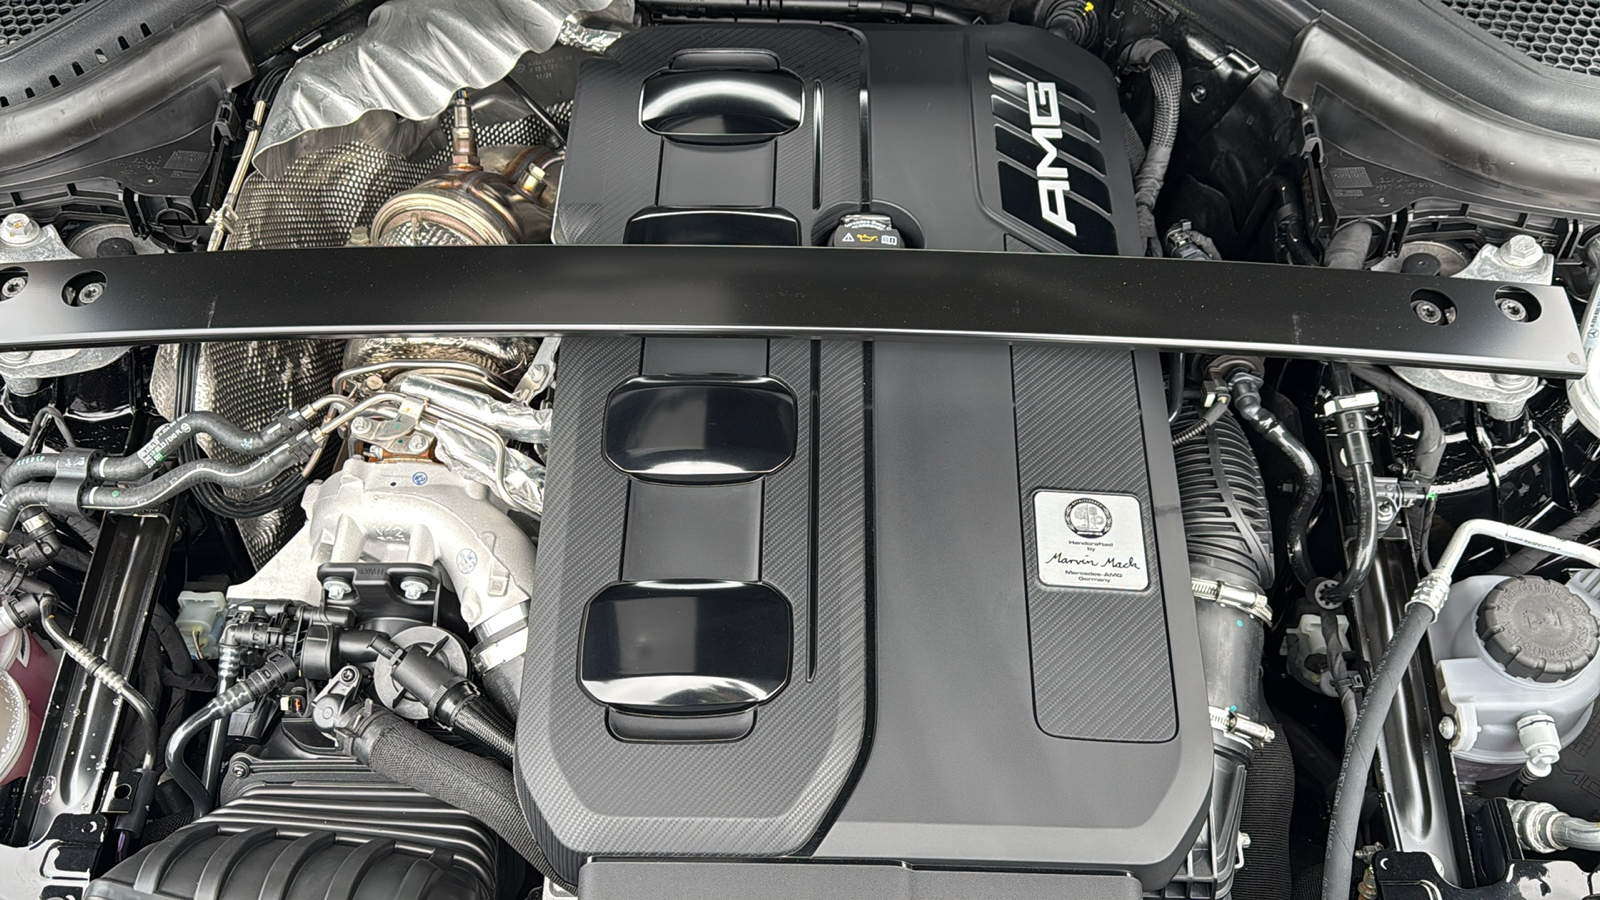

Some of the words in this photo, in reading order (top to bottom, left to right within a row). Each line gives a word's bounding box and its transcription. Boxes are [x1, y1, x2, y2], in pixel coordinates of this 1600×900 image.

[1026, 82, 1077, 237] AMG
[1045, 552, 1098, 566] Marvin
[1065, 570, 1123, 578] Mercedes-AMG
